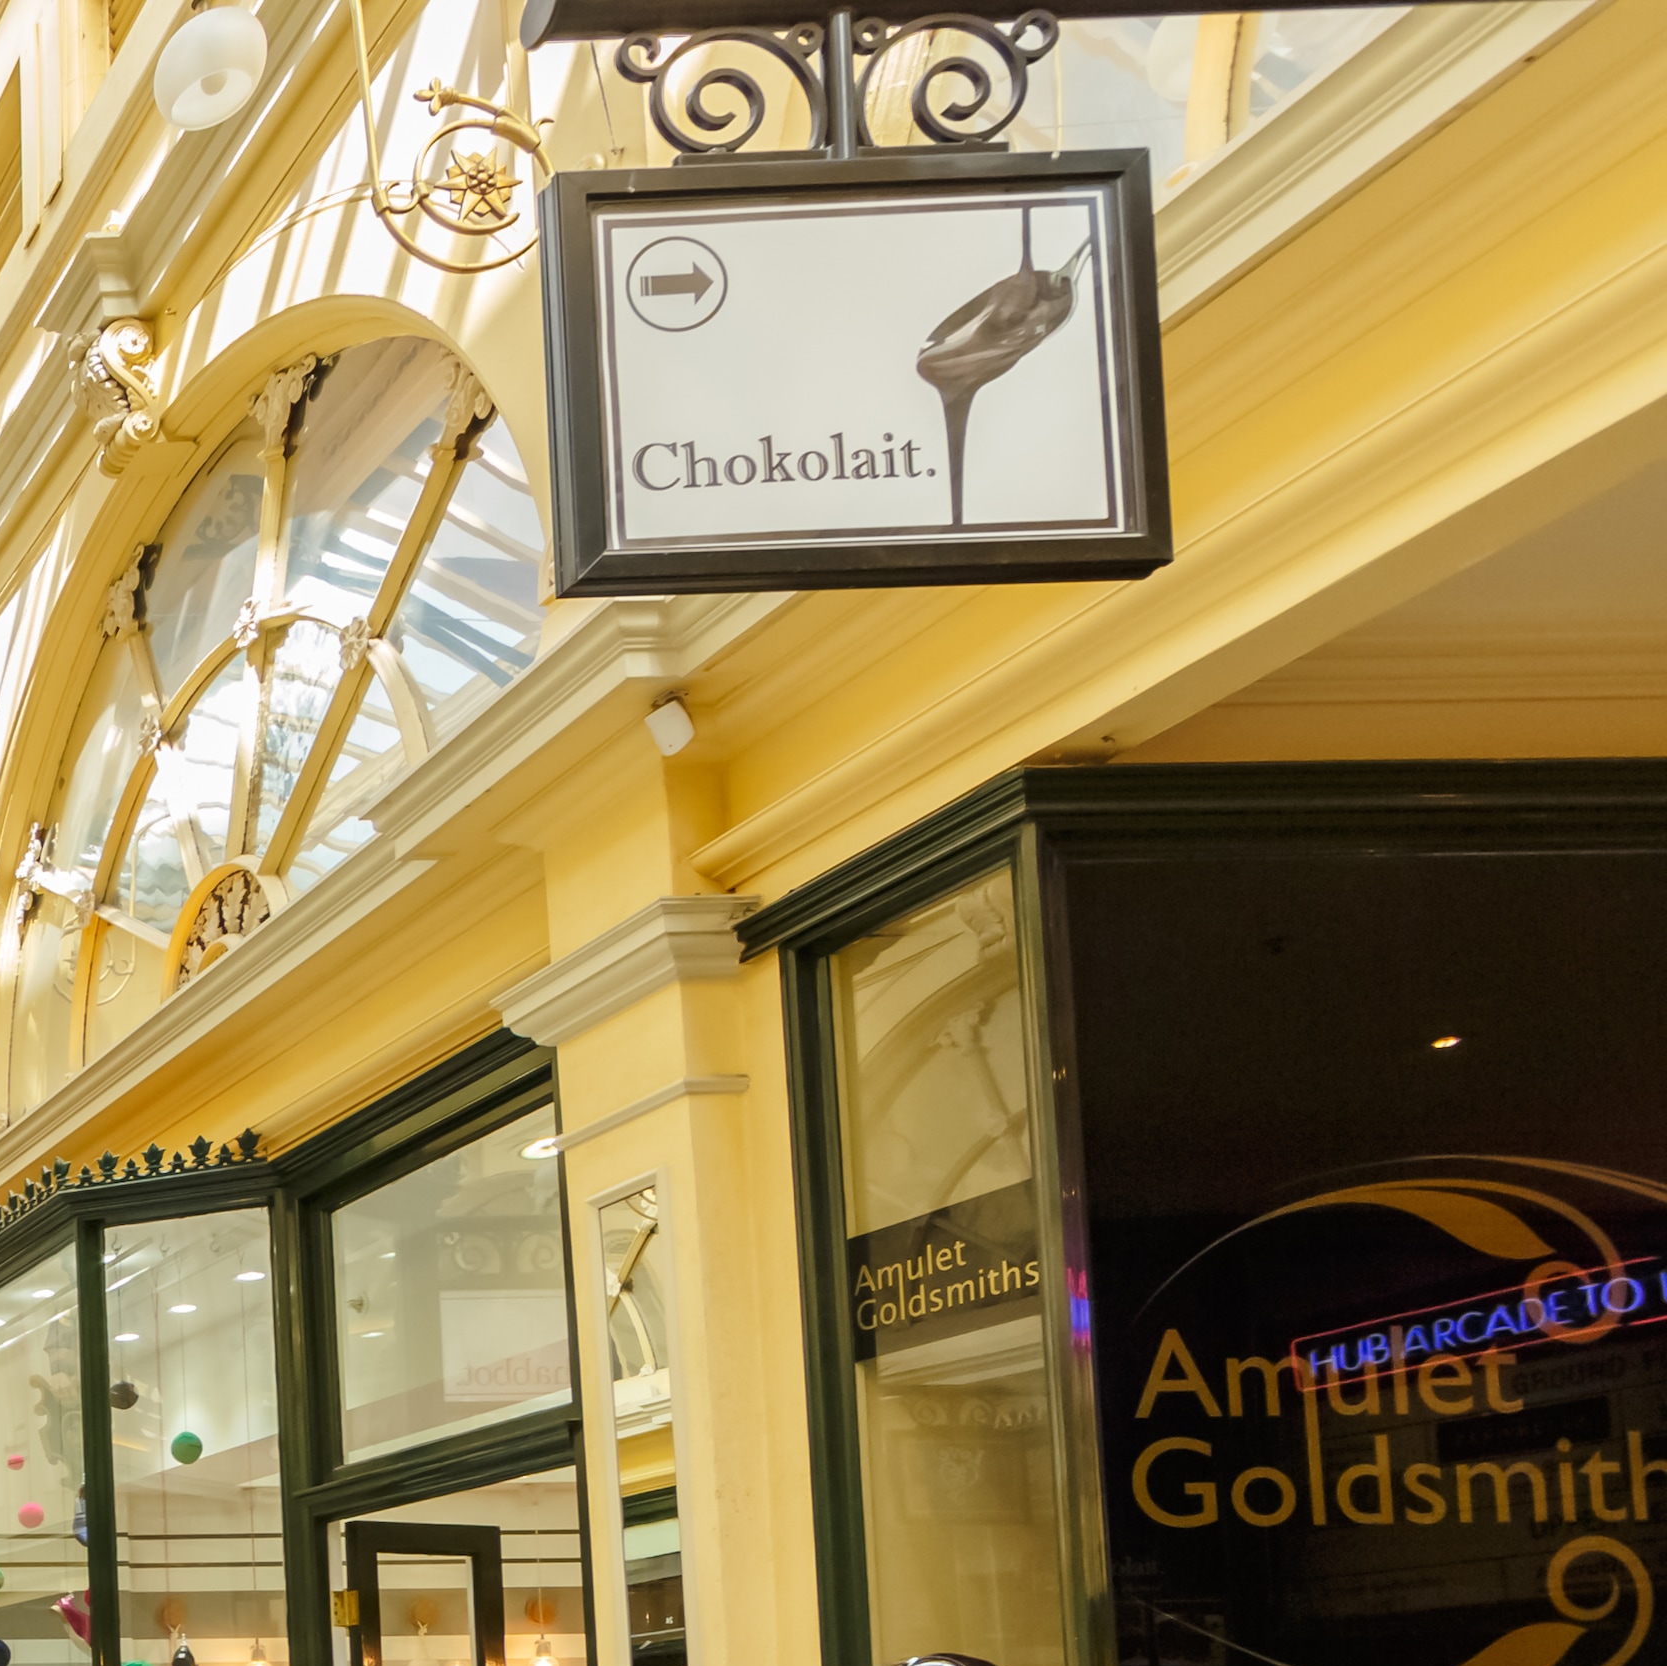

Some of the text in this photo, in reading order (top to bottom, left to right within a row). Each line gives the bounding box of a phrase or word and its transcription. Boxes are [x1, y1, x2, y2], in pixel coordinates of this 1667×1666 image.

[632, 432, 937, 491] Chokolait.
[854, 1240, 967, 1296] Amulet
[856, 1260, 1040, 1330] Goldsmiths
[1310, 1277, 1645, 1378] HUB ARCADE TO
[1135, 1326, 1525, 1420] Amulet
